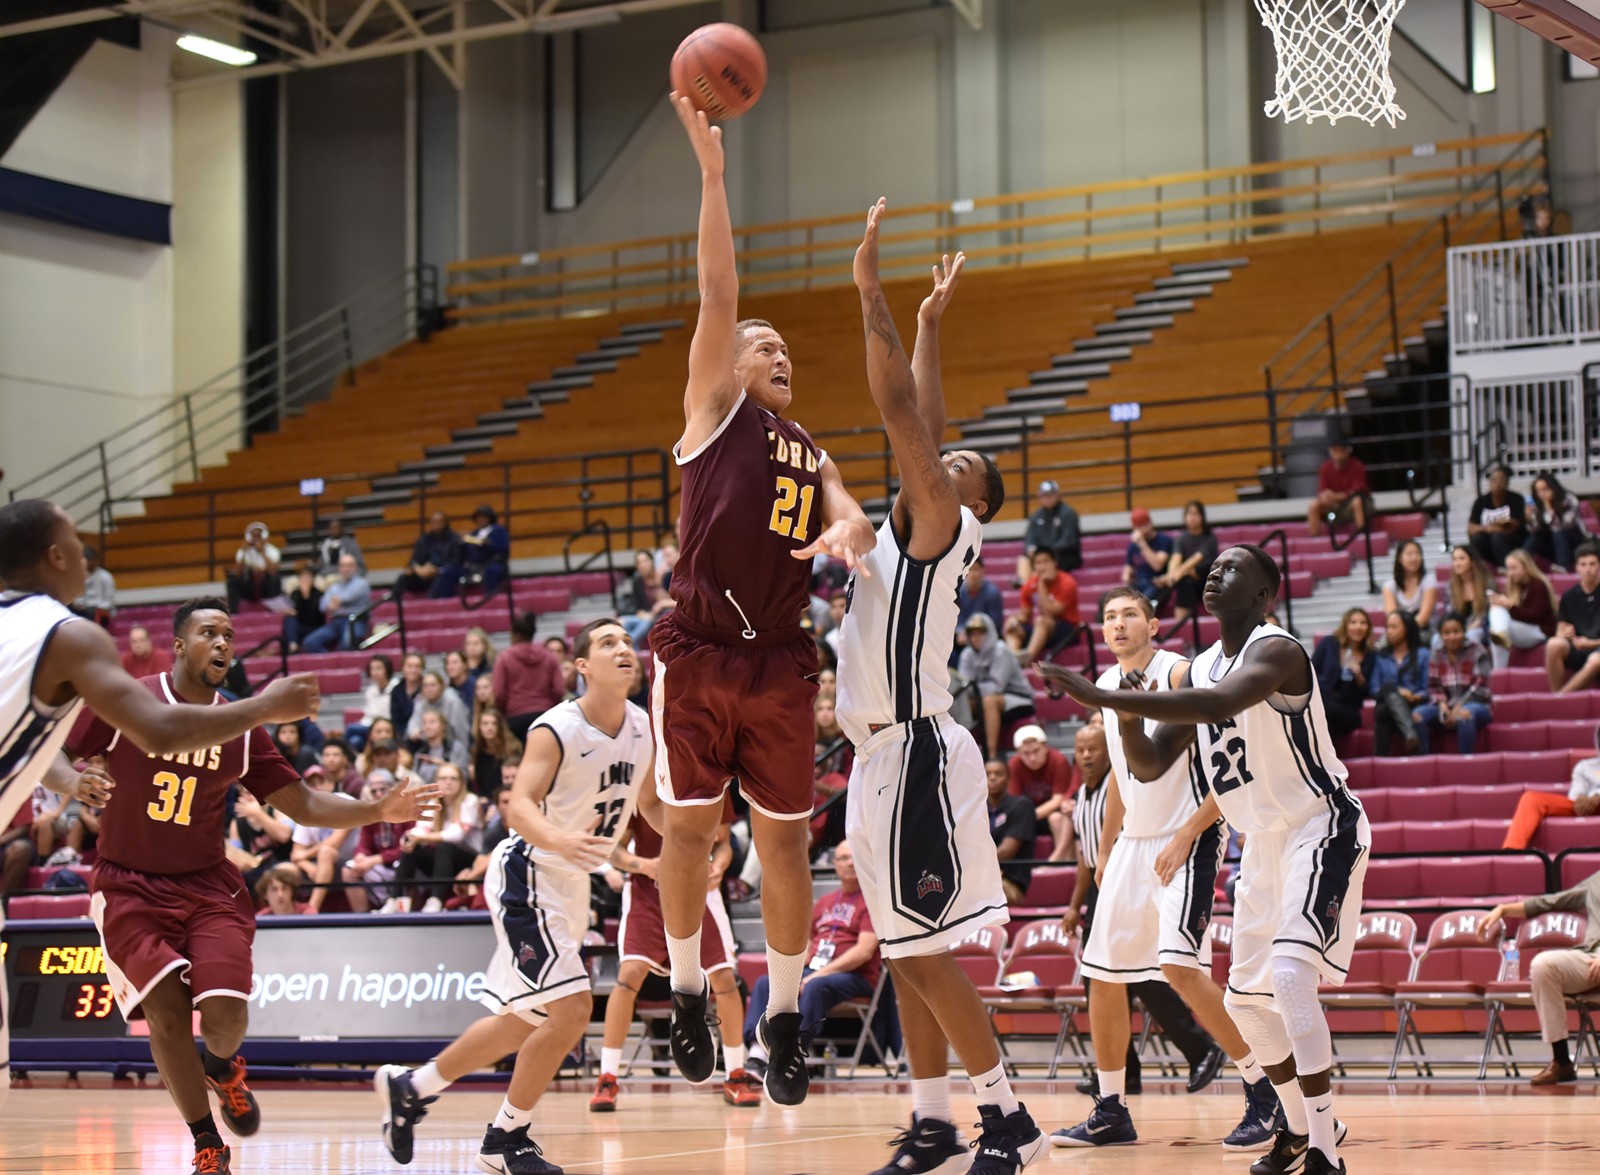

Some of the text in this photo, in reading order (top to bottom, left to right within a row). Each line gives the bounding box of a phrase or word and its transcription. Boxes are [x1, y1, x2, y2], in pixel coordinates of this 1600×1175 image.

[769, 475, 814, 542] 21
[147, 744, 222, 771] ROS
[147, 770, 198, 826] 31
[593, 798, 627, 838] 12
[1356, 915, 1402, 941] LMU
[1442, 915, 1489, 941] LM
[1529, 914, 1580, 940] LMU
[74, 984, 114, 1019] 33
[249, 962, 487, 1009] open happine
